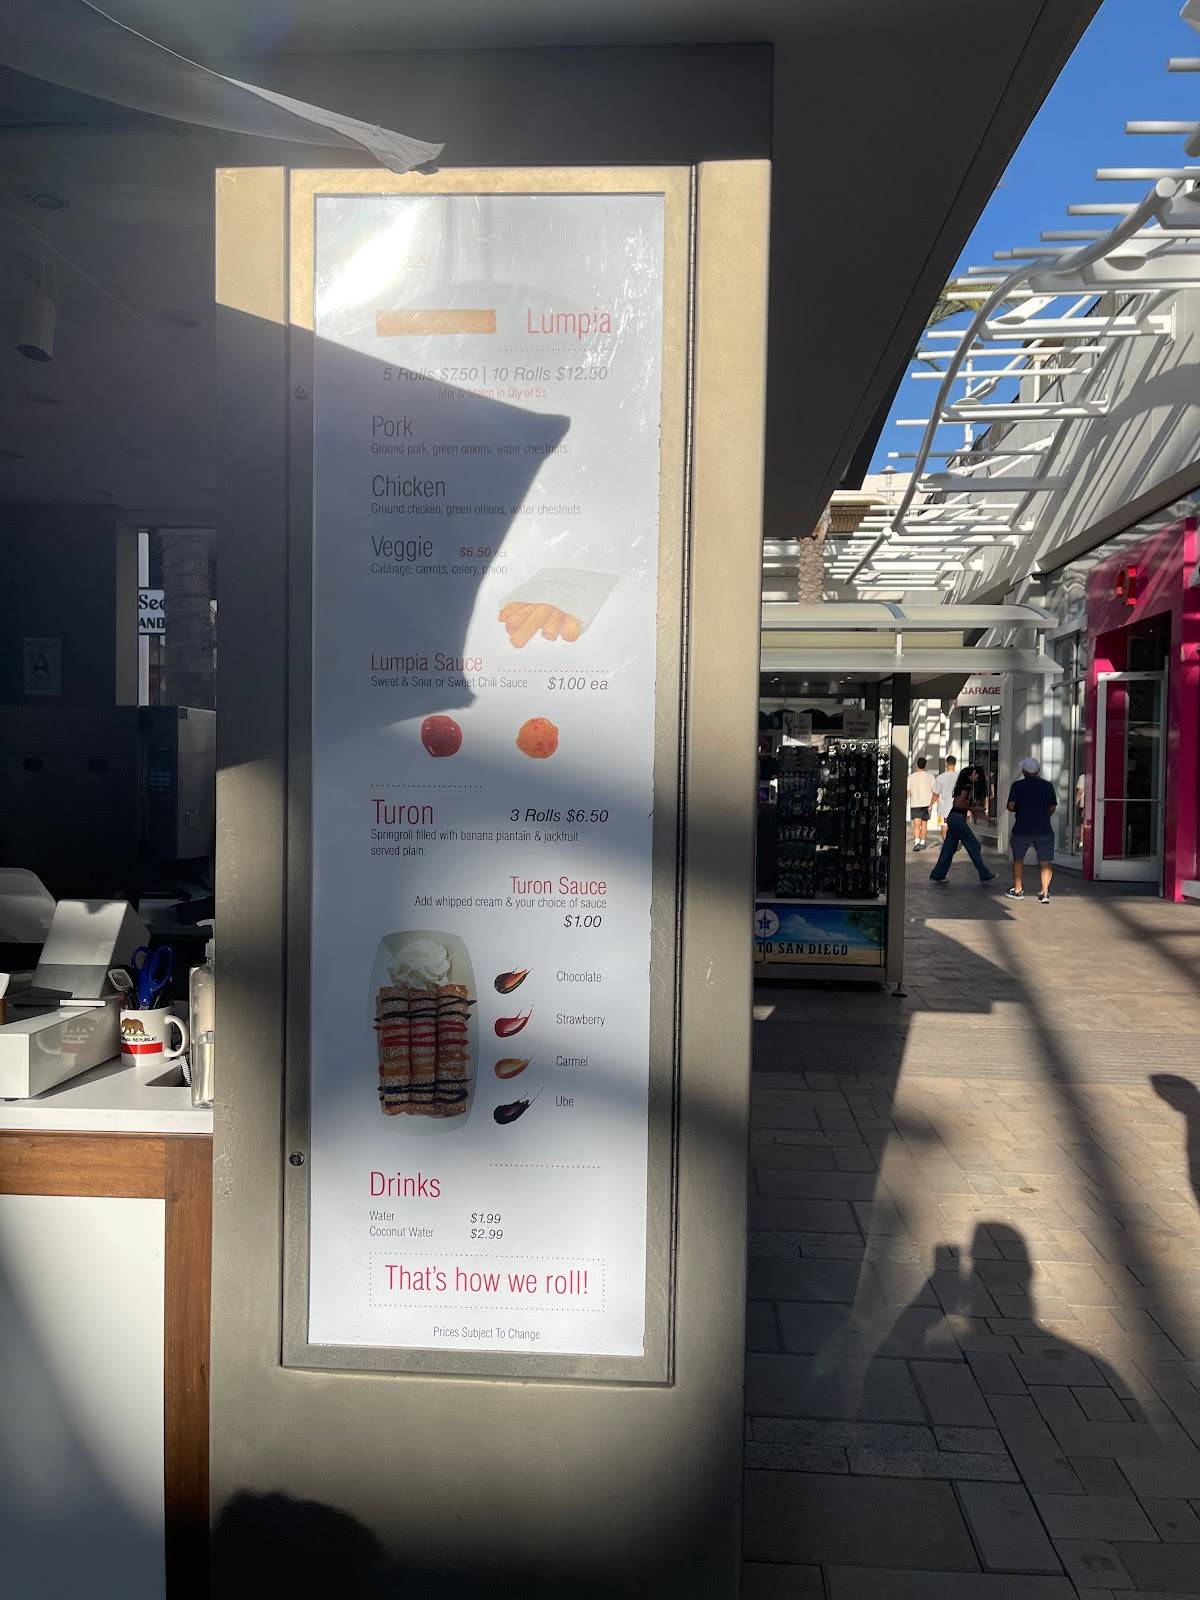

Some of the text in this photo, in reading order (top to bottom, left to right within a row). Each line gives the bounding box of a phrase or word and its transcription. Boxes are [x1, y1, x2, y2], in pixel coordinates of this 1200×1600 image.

[527, 307, 612, 339] Lumpia
[383, 369, 391, 380] 5
[398, 368, 434, 381] Rolls
[439, 368, 478, 381] $7.50
[493, 369, 508, 380] 10
[514, 367, 551, 380] Rolls
[556, 366, 608, 381] $12.50
[438, 389, 455, 399] Mix
[468, 389, 494, 399] Match
[497, 389, 505, 399] in
[524, 388, 534, 399] of
[372, 415, 414, 437] Pork
[371, 443, 568, 456] Ground pork, green onions, water chestnuts
[372, 474, 446, 498] Chicken
[371, 504, 582, 516] Ground chicken, green onions, water chestnuts
[372, 535, 433, 561] Veggie
[460, 547, 492, 558] $6.50
[371, 564, 507, 576] Cabbage, carrots, celery, onion
[371, 653, 483, 674] Lumpia Sauce
[371, 676, 608, 690] Sweet & Sour or Sweet Chili Sauce $1.00 ea
[961, 686, 1001, 695] GARAGE
[372, 799, 608, 824] Turon 3 Rolls $6.50
[371, 829, 579, 844] Springroll filled with banana plantain & jackfruit
[371, 846, 426, 858] served plain.
[510, 876, 606, 894] Turon Sauce
[415, 896, 607, 910] Add whipped cream & your choice of sauce
[564, 915, 602, 928] $1.00
[756, 942, 848, 956] TO SAN DIEGO
[556, 971, 602, 982] Chocolate
[556, 1014, 605, 1027] Strawberry
[556, 1056, 588, 1067] Carmel
[556, 1096, 574, 1106] Ube
[370, 1171, 441, 1198] Drinks
[370, 1211, 501, 1224] Water $1.99
[370, 1226, 504, 1240] Coconut Water $2.99
[385, 1264, 589, 1294] That's how we roll!
[433, 1327, 540, 1340] Prices Subject To Change
